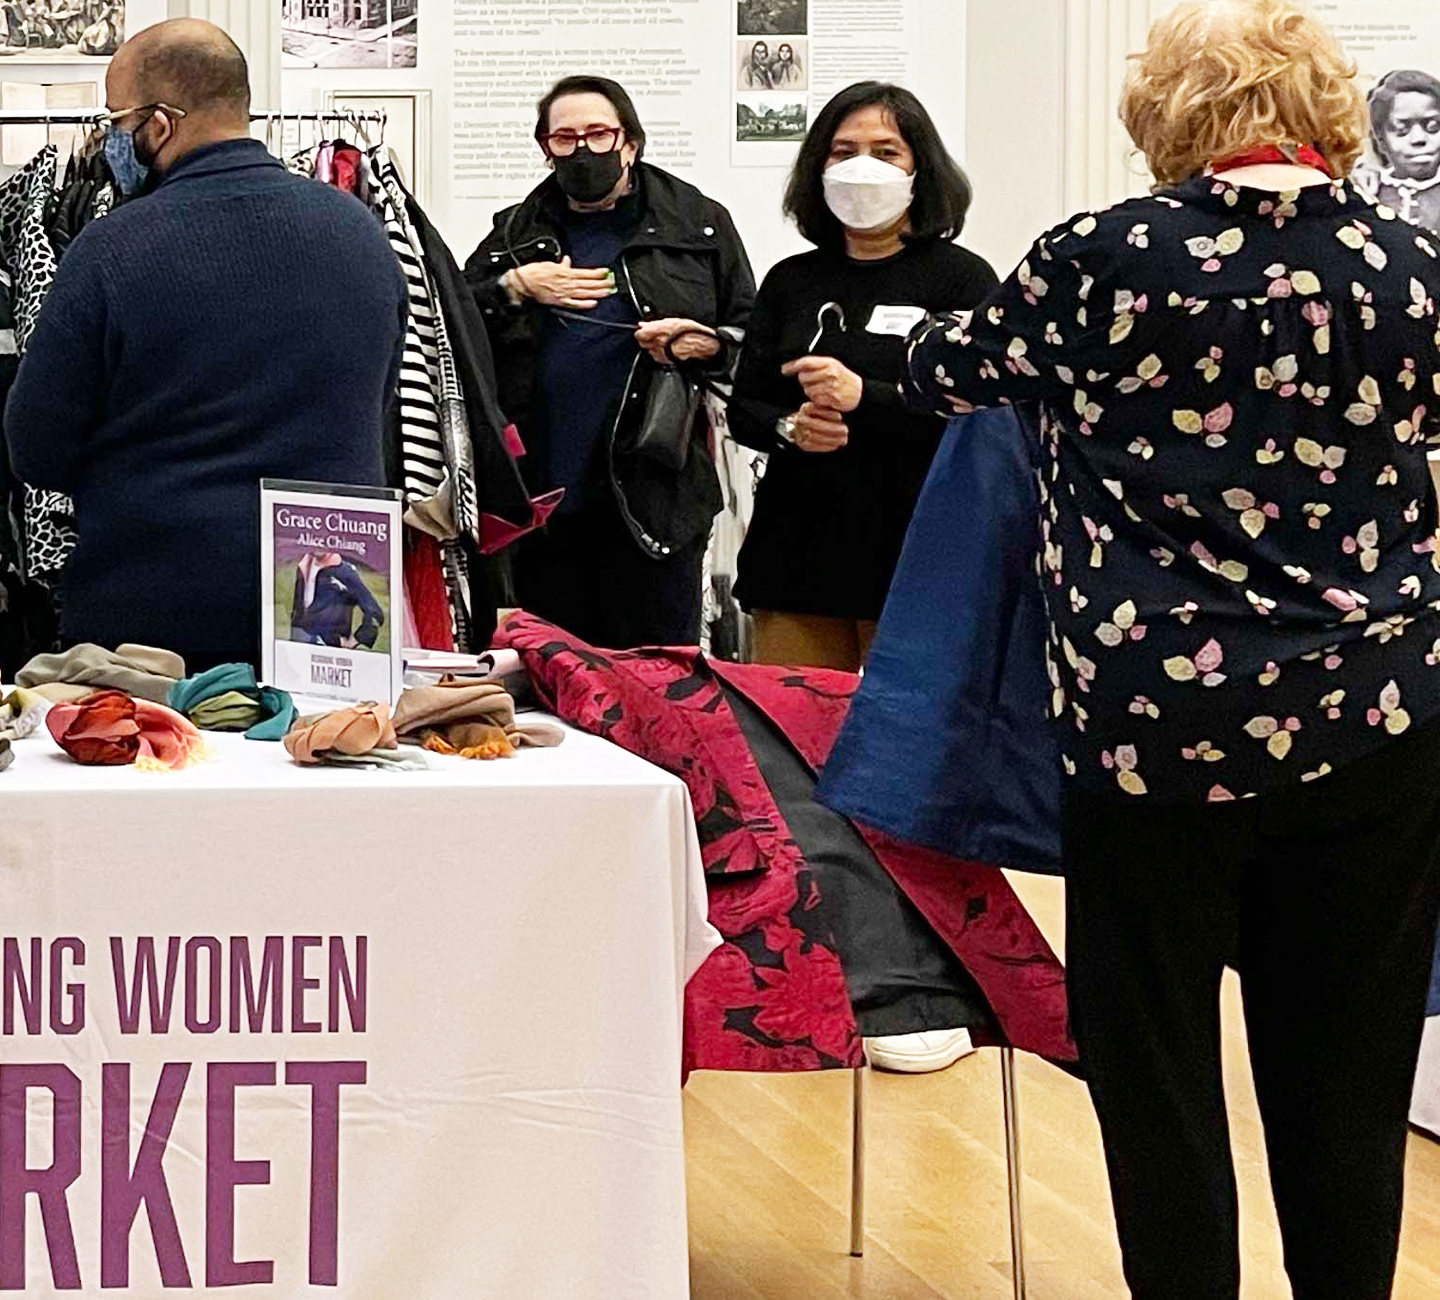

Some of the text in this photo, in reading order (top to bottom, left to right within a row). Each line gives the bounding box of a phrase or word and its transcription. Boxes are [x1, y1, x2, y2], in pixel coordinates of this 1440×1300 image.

[276, 508, 388, 541] Grace Chuang
[297, 533, 366, 555] Alice Chiang
[311, 664, 352, 688] MARKET
[109, 935, 368, 1034] WOMEN
